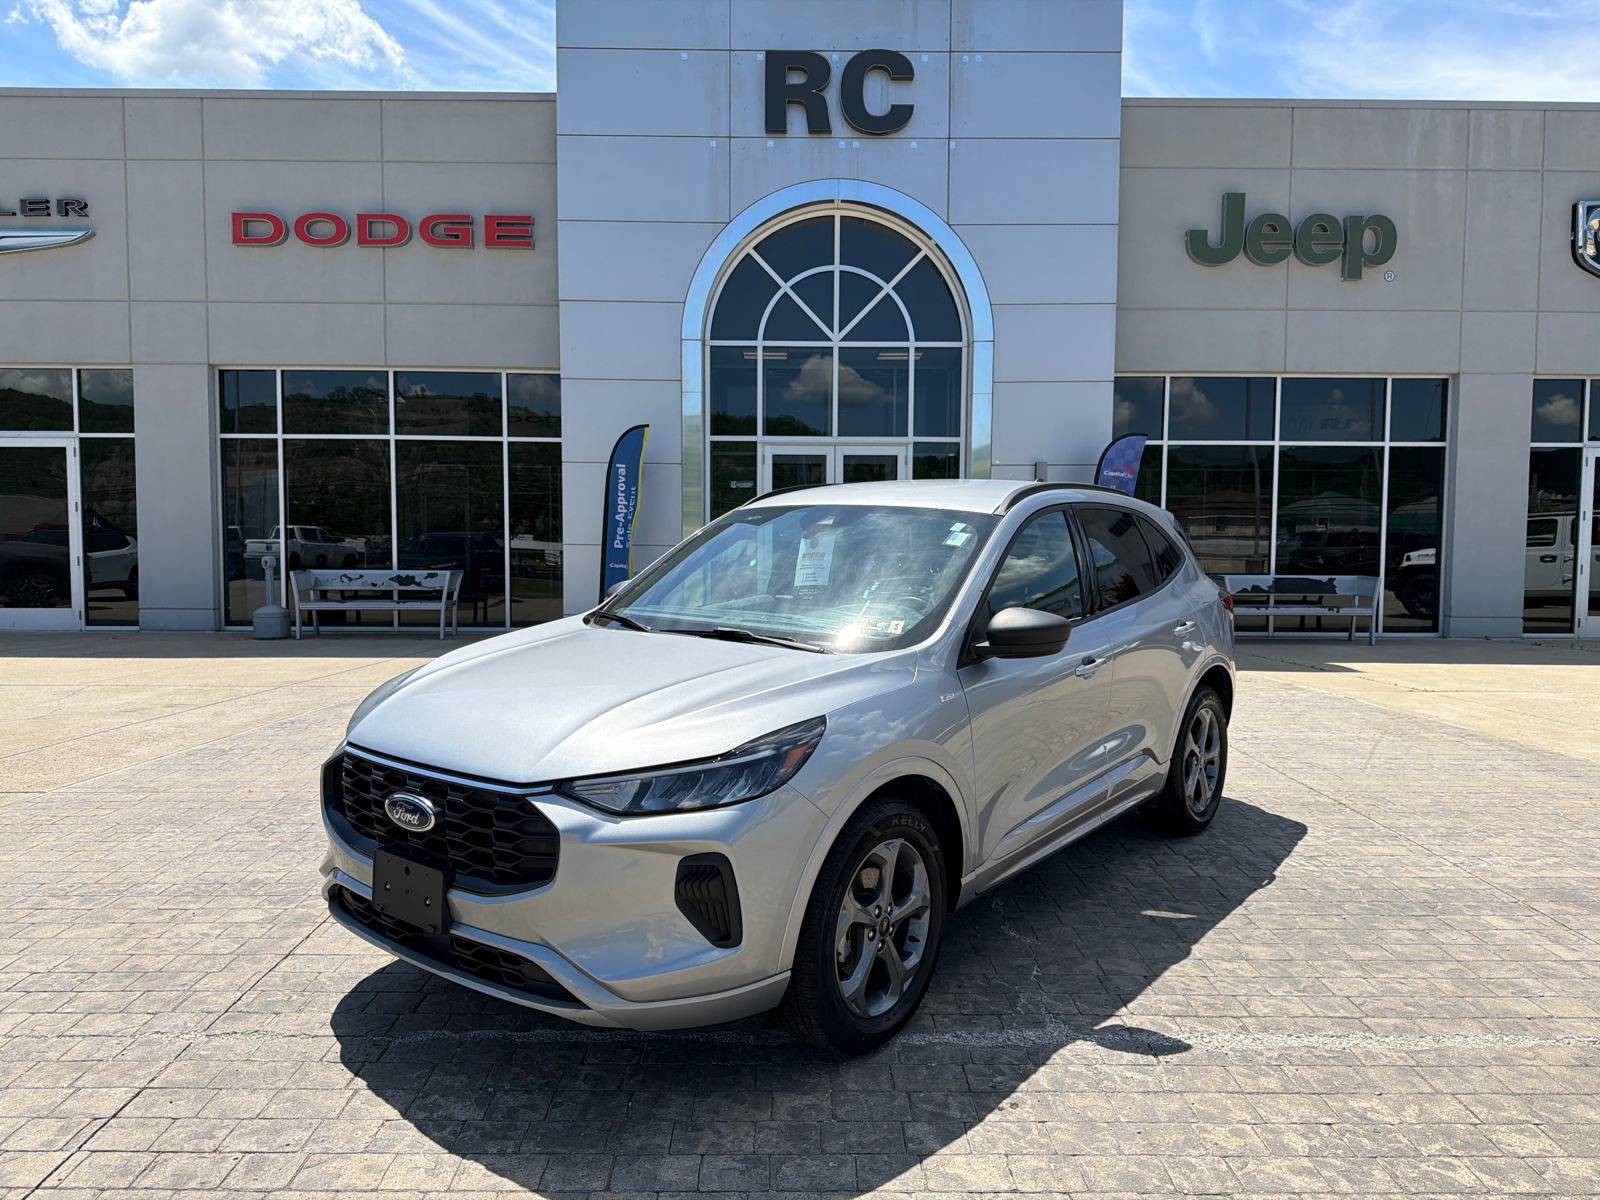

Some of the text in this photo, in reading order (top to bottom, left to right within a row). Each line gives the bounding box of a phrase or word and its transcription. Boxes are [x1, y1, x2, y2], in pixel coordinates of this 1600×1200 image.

[765, 49, 914, 136] RC
[232, 212, 535, 249] DODGE
[1185, 192, 1398, 281] Jeep
[613, 463, 628, 549] Pre-Approval
[393, 801, 421, 825] Ford
[891, 815, 926, 832] KELLY
